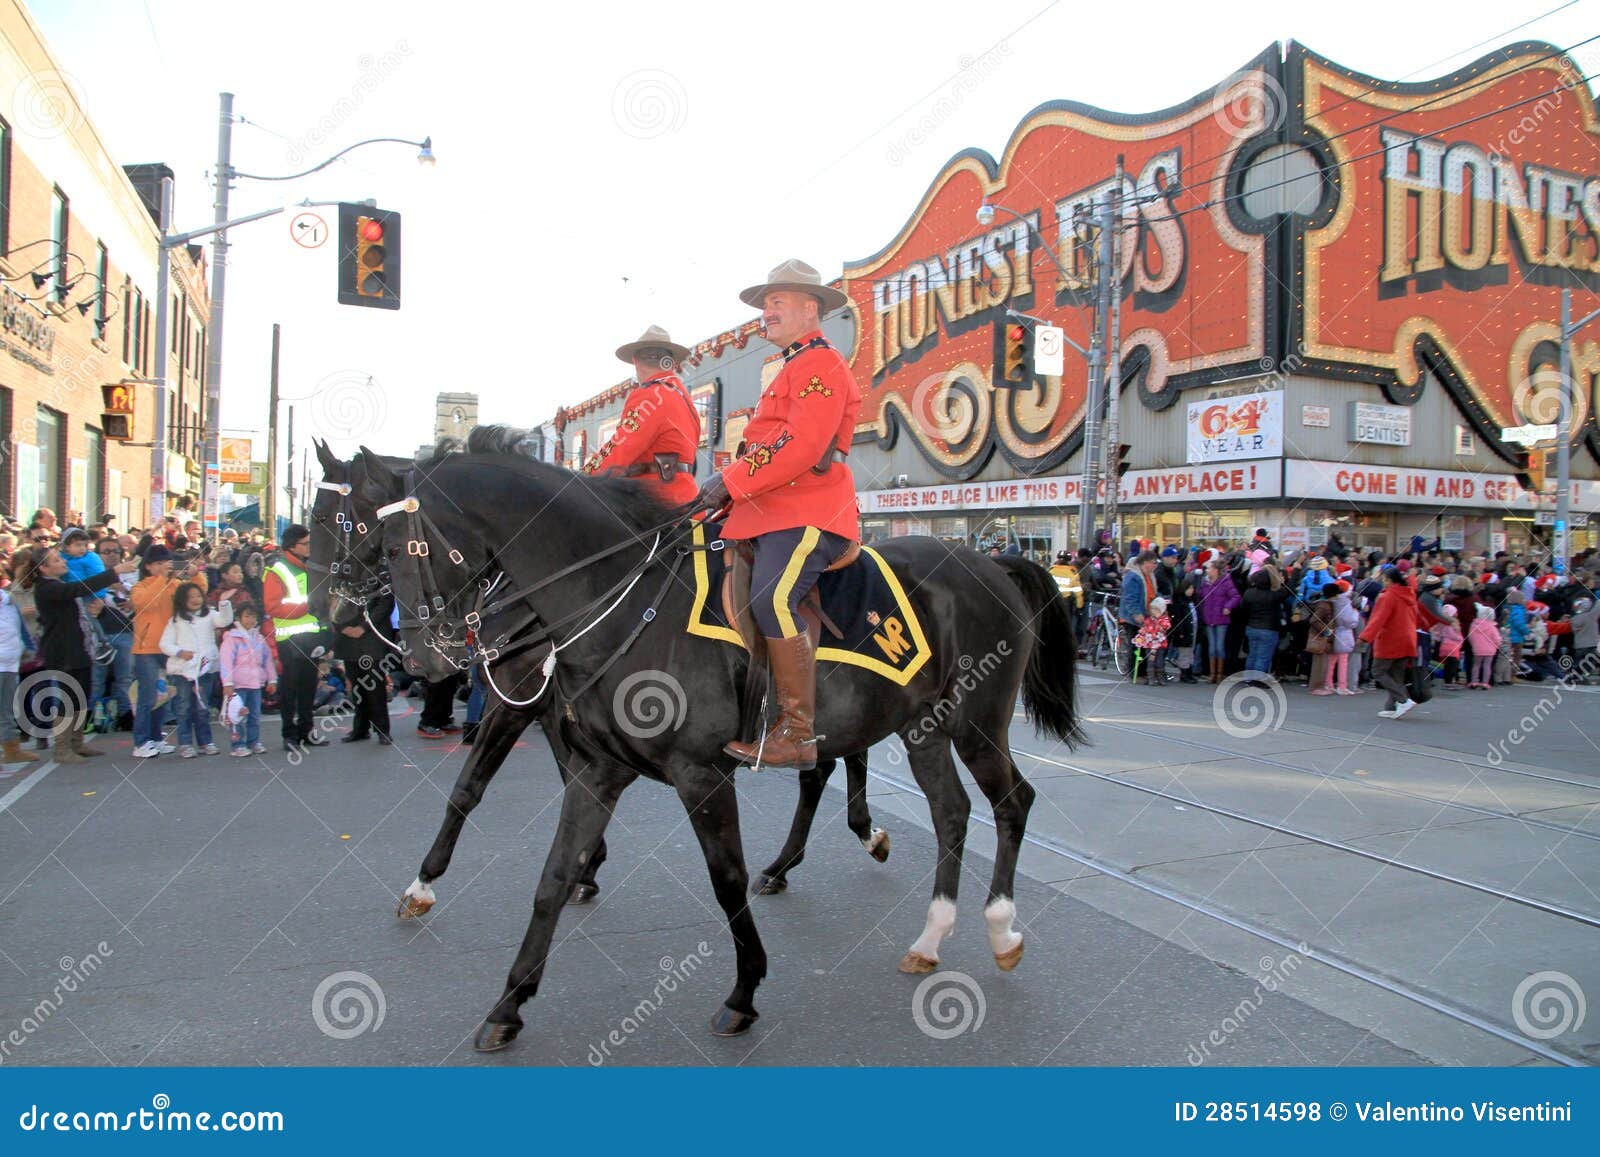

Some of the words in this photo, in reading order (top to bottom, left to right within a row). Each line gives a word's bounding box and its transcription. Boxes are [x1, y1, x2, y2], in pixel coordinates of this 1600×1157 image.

[872, 208, 1041, 381] HONEST
[1201, 434, 1264, 454] YEAR
[1358, 425, 1409, 443] DENTIST
[876, 490, 918, 508] THERE'S
[922, 490, 937, 506] NO
[941, 487, 981, 505] PLACE
[987, 484, 1018, 501] LIKE
[1024, 482, 1058, 500] THIS
[1335, 470, 1398, 495] COME
[1406, 475, 1427, 497] IN
[1434, 477, 1475, 499] AND
[1484, 480, 1519, 502] GET
